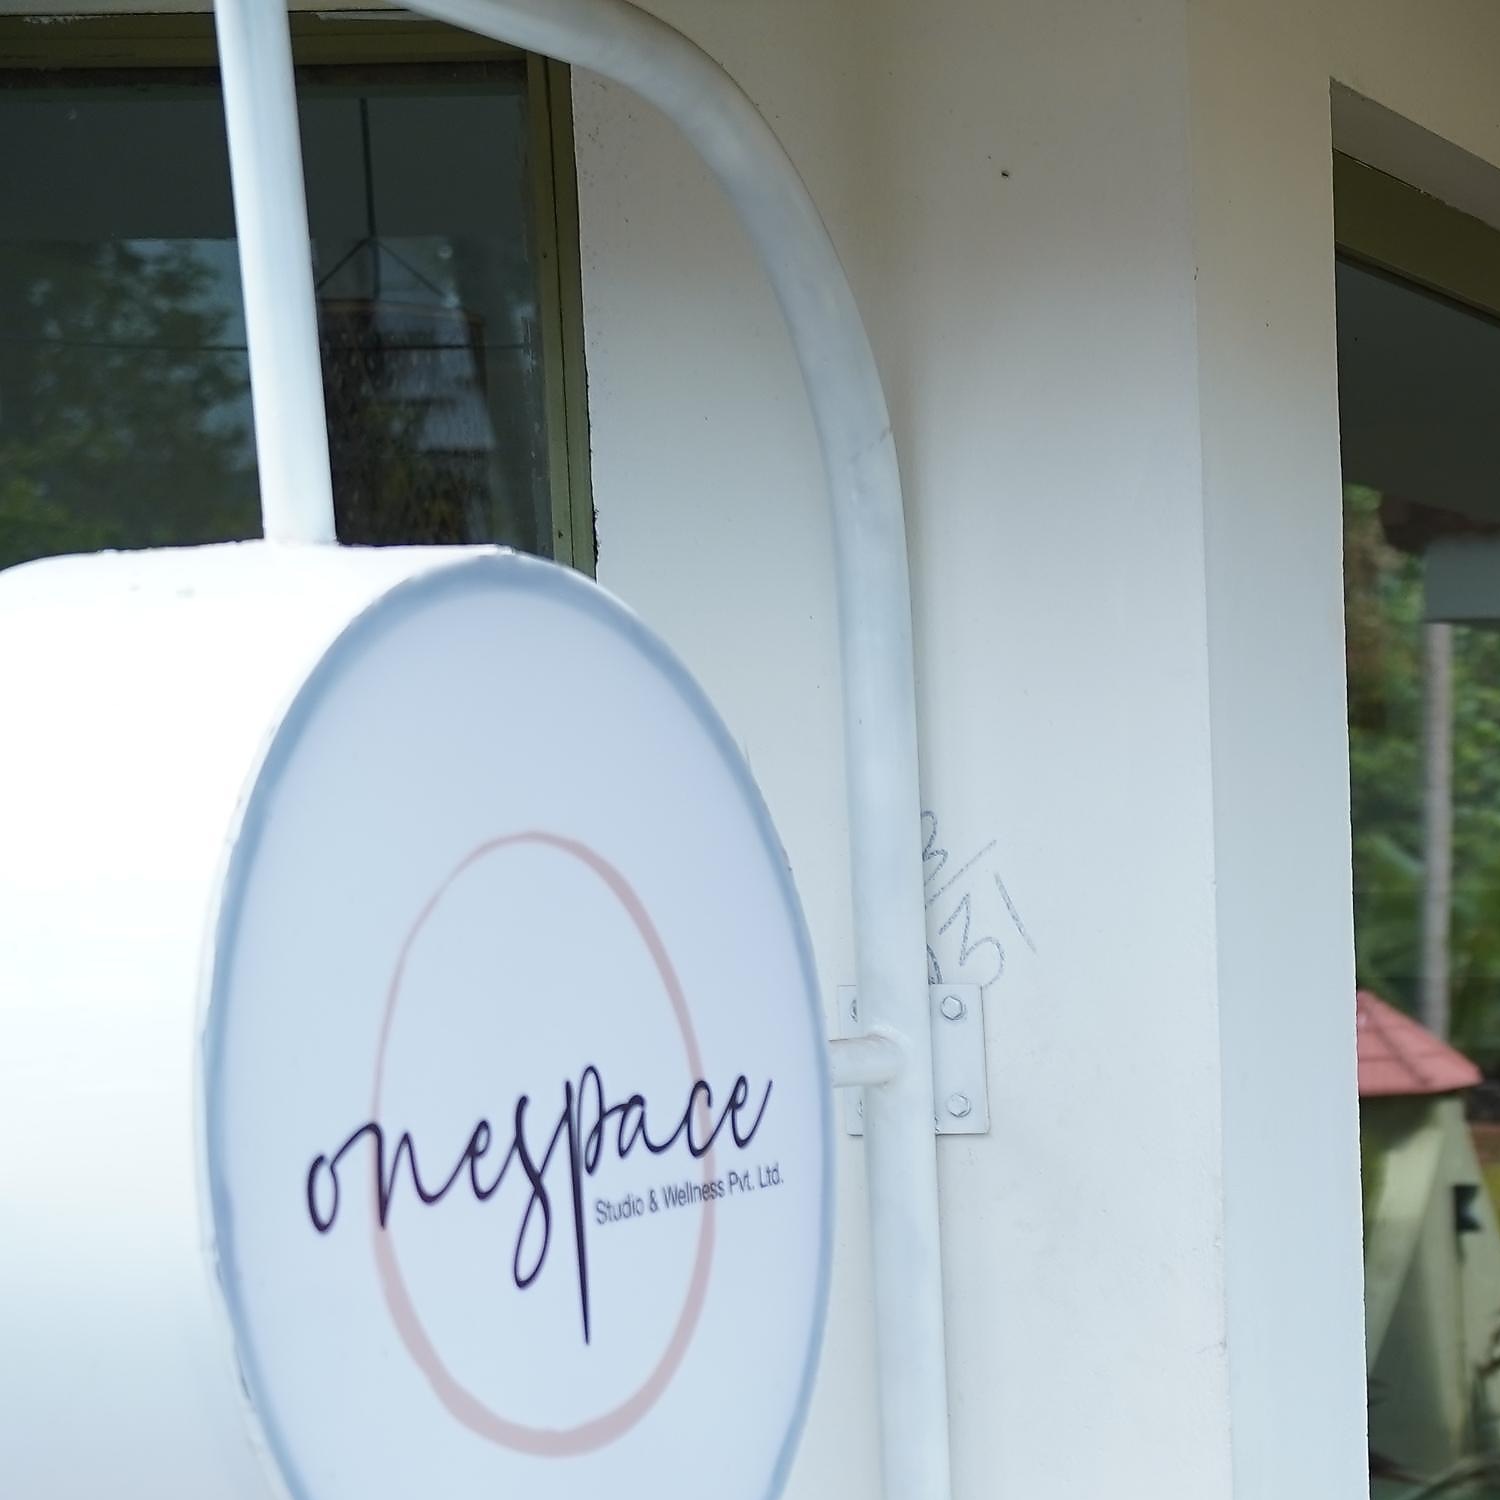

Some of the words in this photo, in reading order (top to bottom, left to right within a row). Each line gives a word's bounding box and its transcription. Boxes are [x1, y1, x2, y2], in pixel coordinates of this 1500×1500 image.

[307, 1065, 773, 1345] onespace
[595, 1195, 644, 1225] Studio
[649, 1189, 659, 1213] &
[662, 1181, 726, 1209] Wellness
[728, 1171, 755, 1194] Pvt.
[758, 1162, 784, 1187] Ltd.
